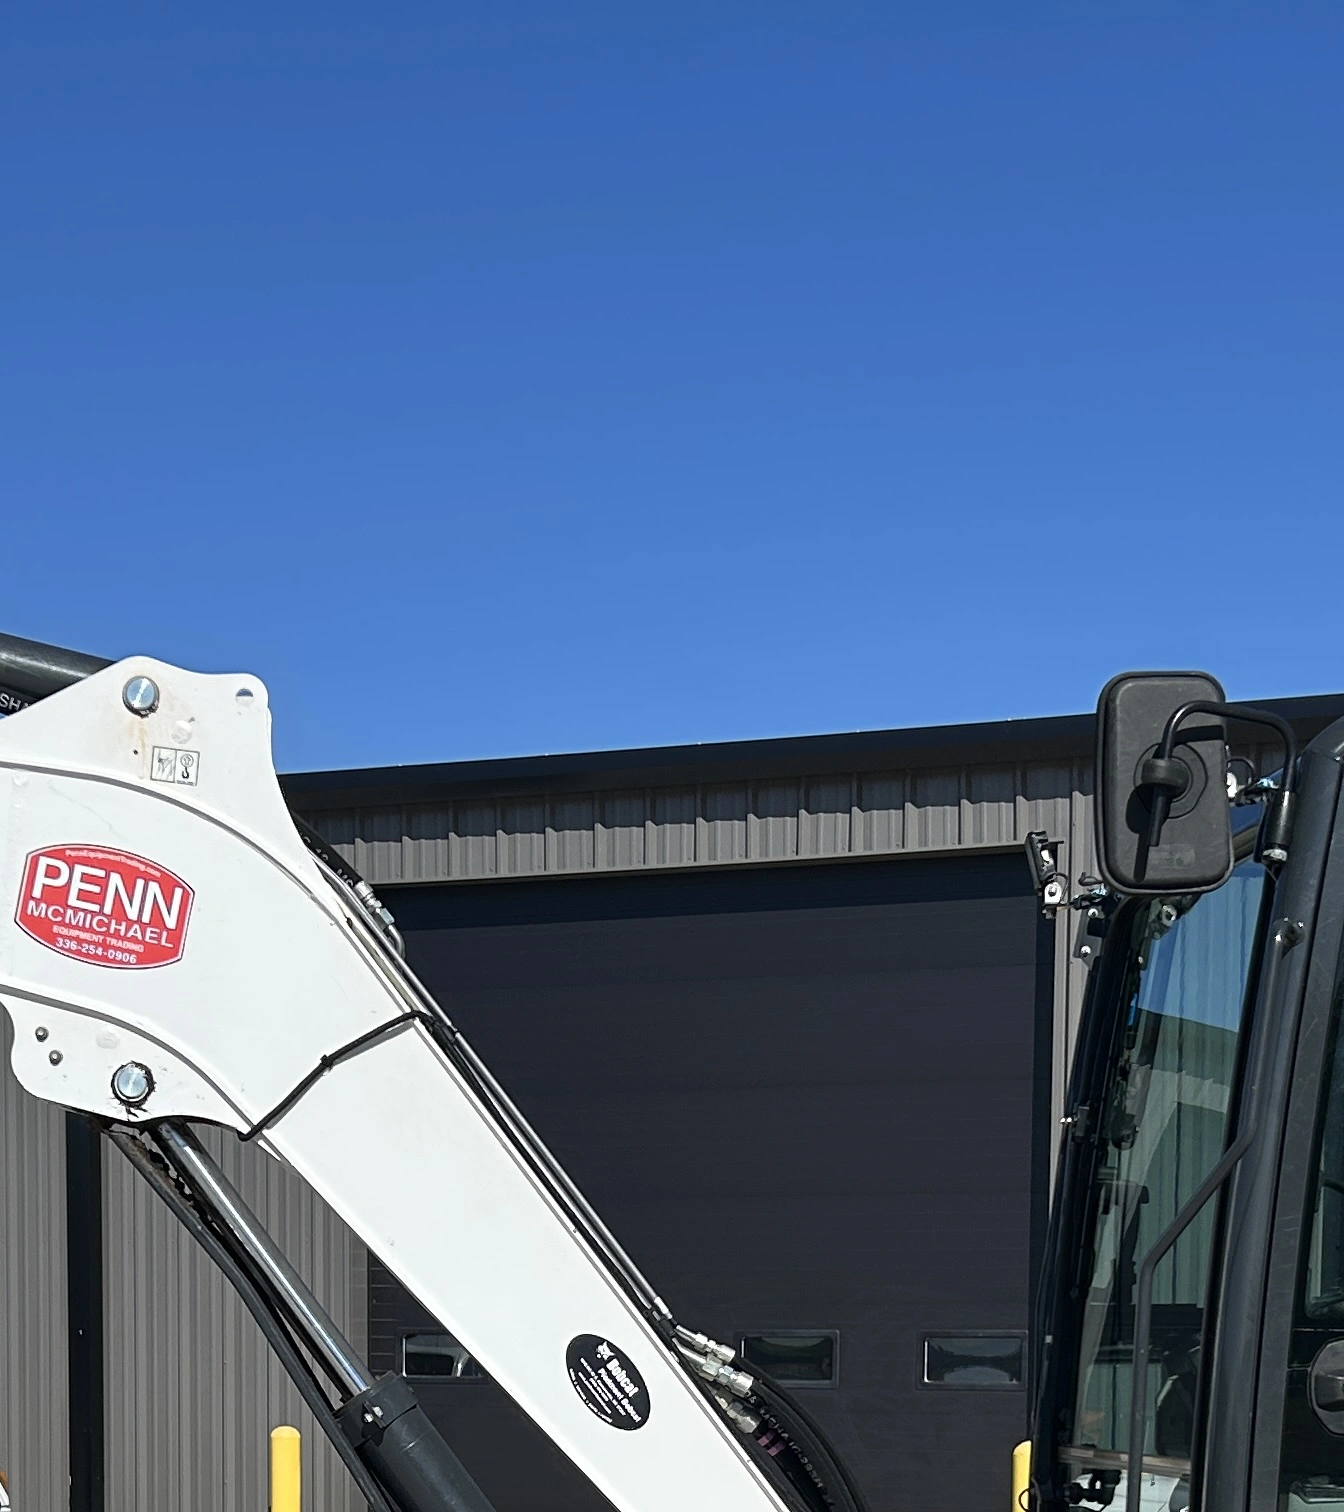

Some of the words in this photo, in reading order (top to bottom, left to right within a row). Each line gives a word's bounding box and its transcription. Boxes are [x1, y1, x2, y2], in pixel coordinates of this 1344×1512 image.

[30, 855, 184, 930] PENN
[26, 900, 174, 948] MCMICHAEL
[53, 924, 104, 943] EQUIPMENT
[106, 936, 144, 953] TRADING
[56, 937, 137, 964] 336-254-0906
[606, 1358, 639, 1397] Bobcat
